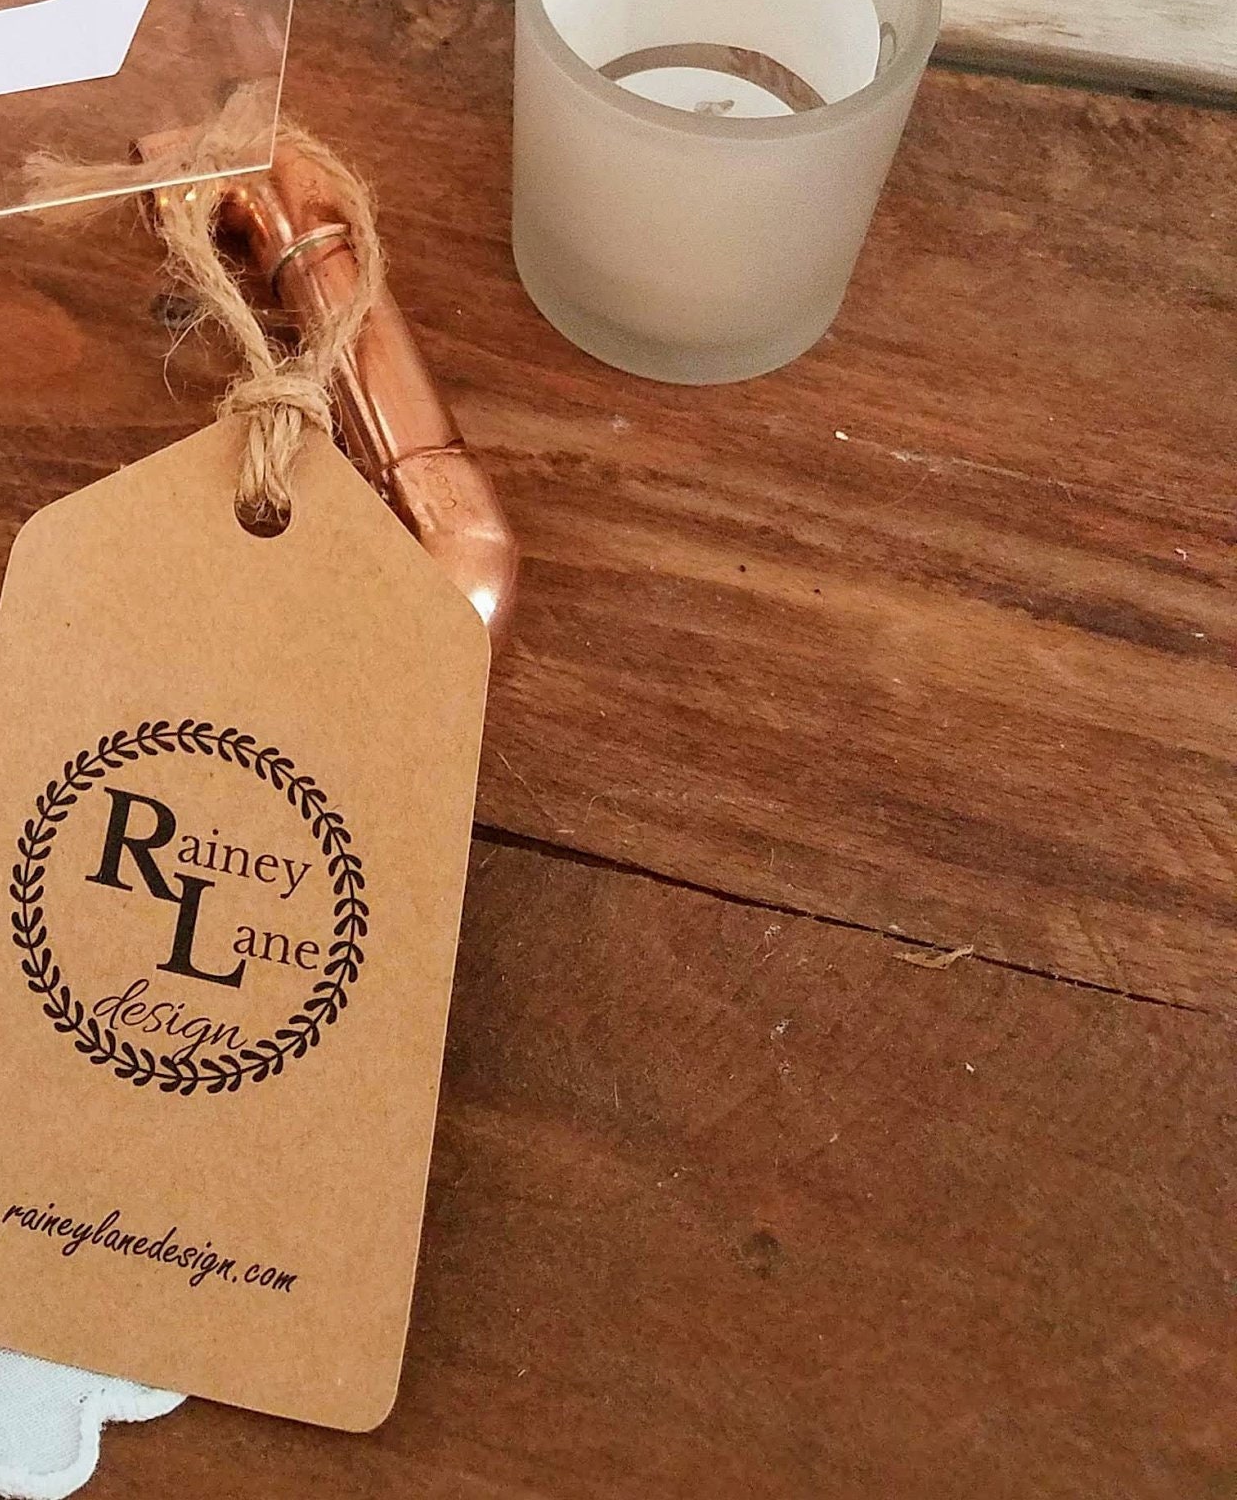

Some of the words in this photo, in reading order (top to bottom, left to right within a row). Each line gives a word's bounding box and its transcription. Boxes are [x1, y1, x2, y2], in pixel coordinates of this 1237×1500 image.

[85, 786, 312, 902] Rainey
[156, 872, 320, 989] Lane
[92, 978, 248, 1065] design
